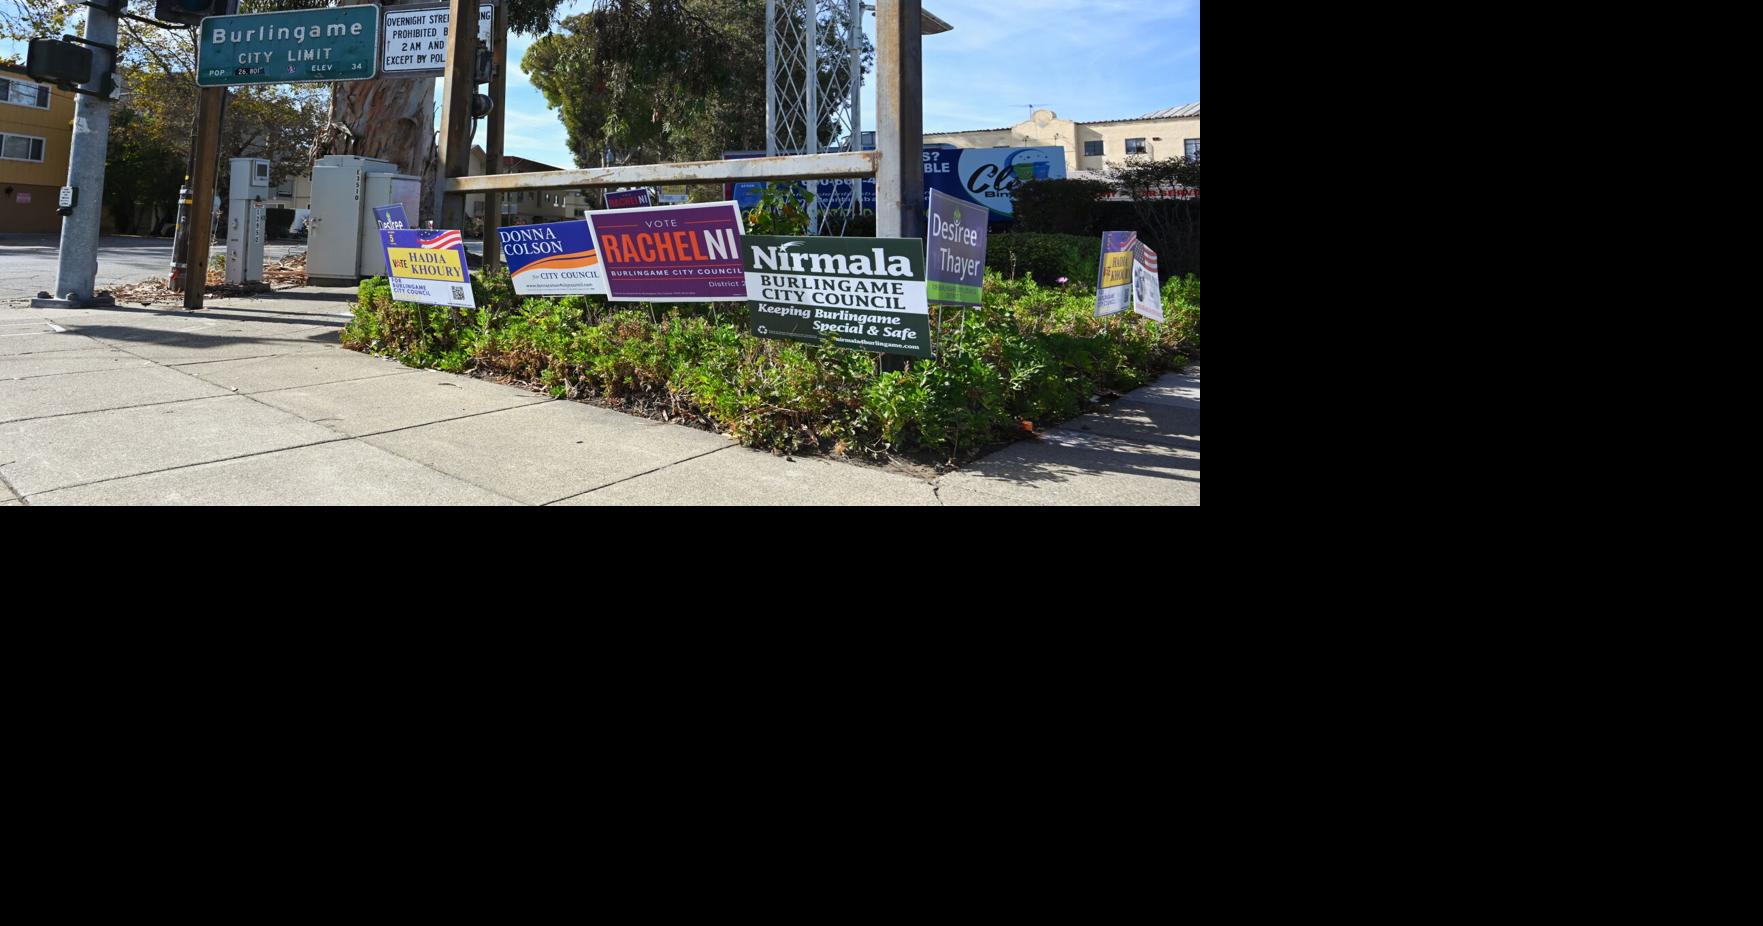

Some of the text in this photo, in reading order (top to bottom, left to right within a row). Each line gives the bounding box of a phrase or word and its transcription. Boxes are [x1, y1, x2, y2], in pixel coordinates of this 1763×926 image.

[387, 16, 426, 27] OVERNIGHT
[212, 22, 363, 44] Burlingame
[392, 28, 437, 39] PROHIBITED
[428, 40, 444, 50] AND
[238, 48, 332, 64] CITY LIMIT
[386, 55, 413, 66] EXCEPT
[416, 54, 427, 64] BY
[311, 64, 333, 72] ELEV
[645, 219, 678, 229] VOTE
[932, 212, 978, 248] Desiree
[499, 227, 557, 243] DONNA
[503, 240, 564, 256] COLSON
[408, 252, 447, 264] HADIA
[751, 243, 914, 278] Nirmala
[939, 247, 981, 281] Thayer
[411, 265, 461, 277] KHOURY
[540, 272, 558, 280] CITY
[560, 271, 599, 279] COUNCIL
[610, 269, 669, 277] BURLINGAME
[392, 283, 427, 291] BURLINGAME
[708, 280, 739, 288] District
[760, 274, 905, 295] BURLINGAME
[407, 288, 431, 296] COUNCIL
[762, 287, 906, 310] CITY COUNCIL
[758, 303, 901, 327] Keeping Burlingame
[812, 320, 864, 335] Special
[866, 323, 880, 336] &
[882, 326, 918, 341] Safe
